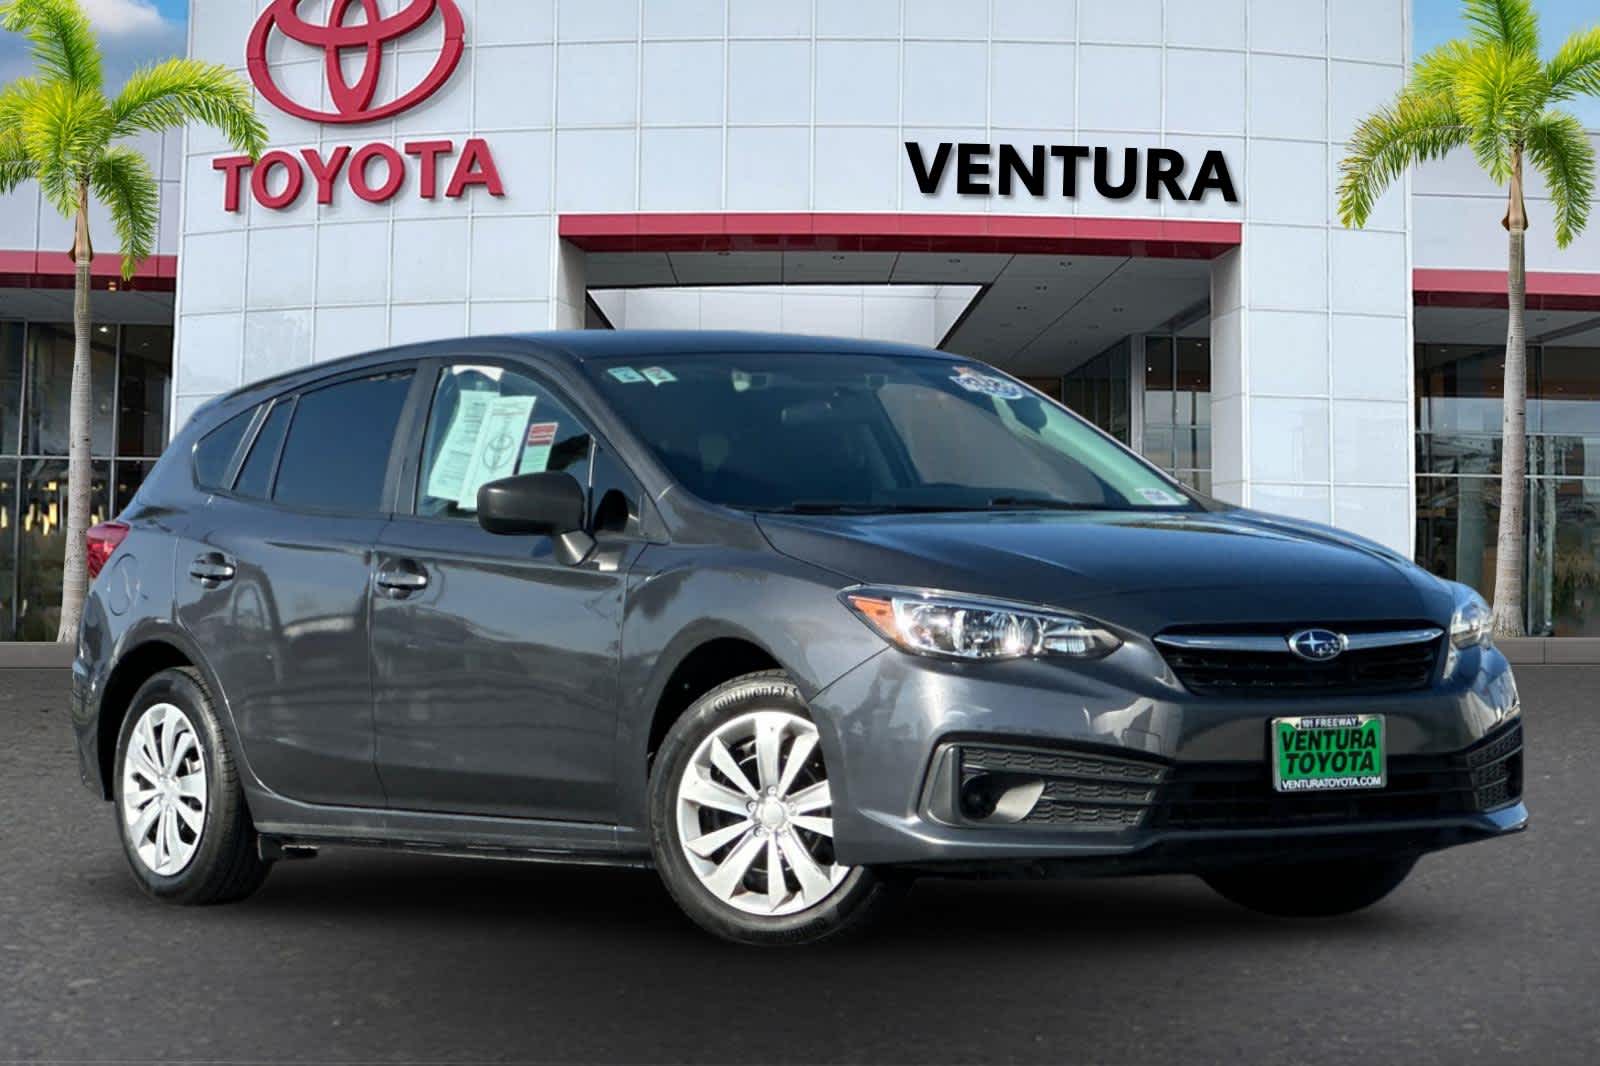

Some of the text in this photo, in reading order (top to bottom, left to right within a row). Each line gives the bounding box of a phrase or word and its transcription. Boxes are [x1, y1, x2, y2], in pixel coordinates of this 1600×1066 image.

[213, 139, 504, 212] TOYOTA
[905, 142, 1238, 202] VENTURA
[1315, 717, 1357, 728] FREEWAY
[1281, 728, 1376, 751] VENTURA
[1285, 751, 1374, 774] TOYOTA
[1282, 776, 1381, 790] VENTURATOYOTA.COM
